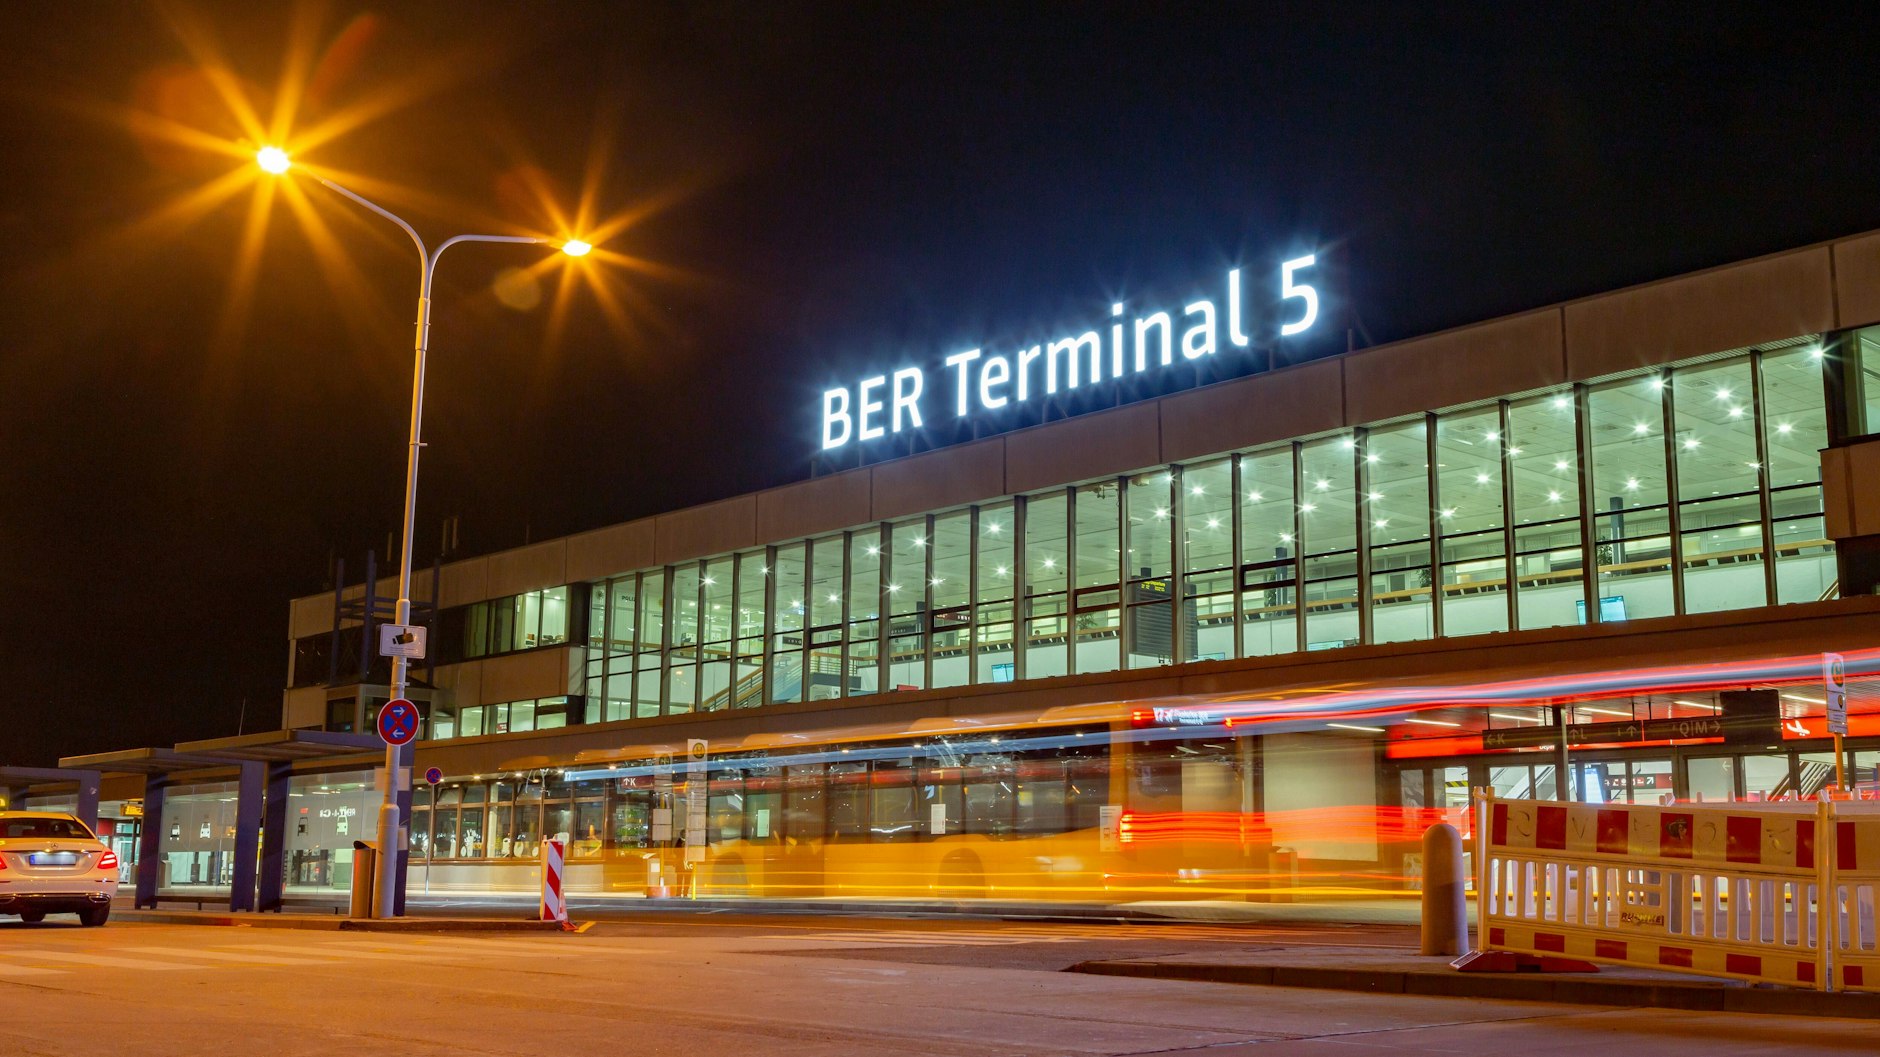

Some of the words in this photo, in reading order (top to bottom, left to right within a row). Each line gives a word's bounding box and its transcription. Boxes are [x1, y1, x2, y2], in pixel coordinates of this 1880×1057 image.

[821, 367, 924, 451] BER
[945, 268, 1249, 418] Terminal
[1280, 254, 1319, 336] 5
[1496, 733, 1505, 745] K
[1580, 728, 1588, 740] L
[630, 777, 636, 786] K
